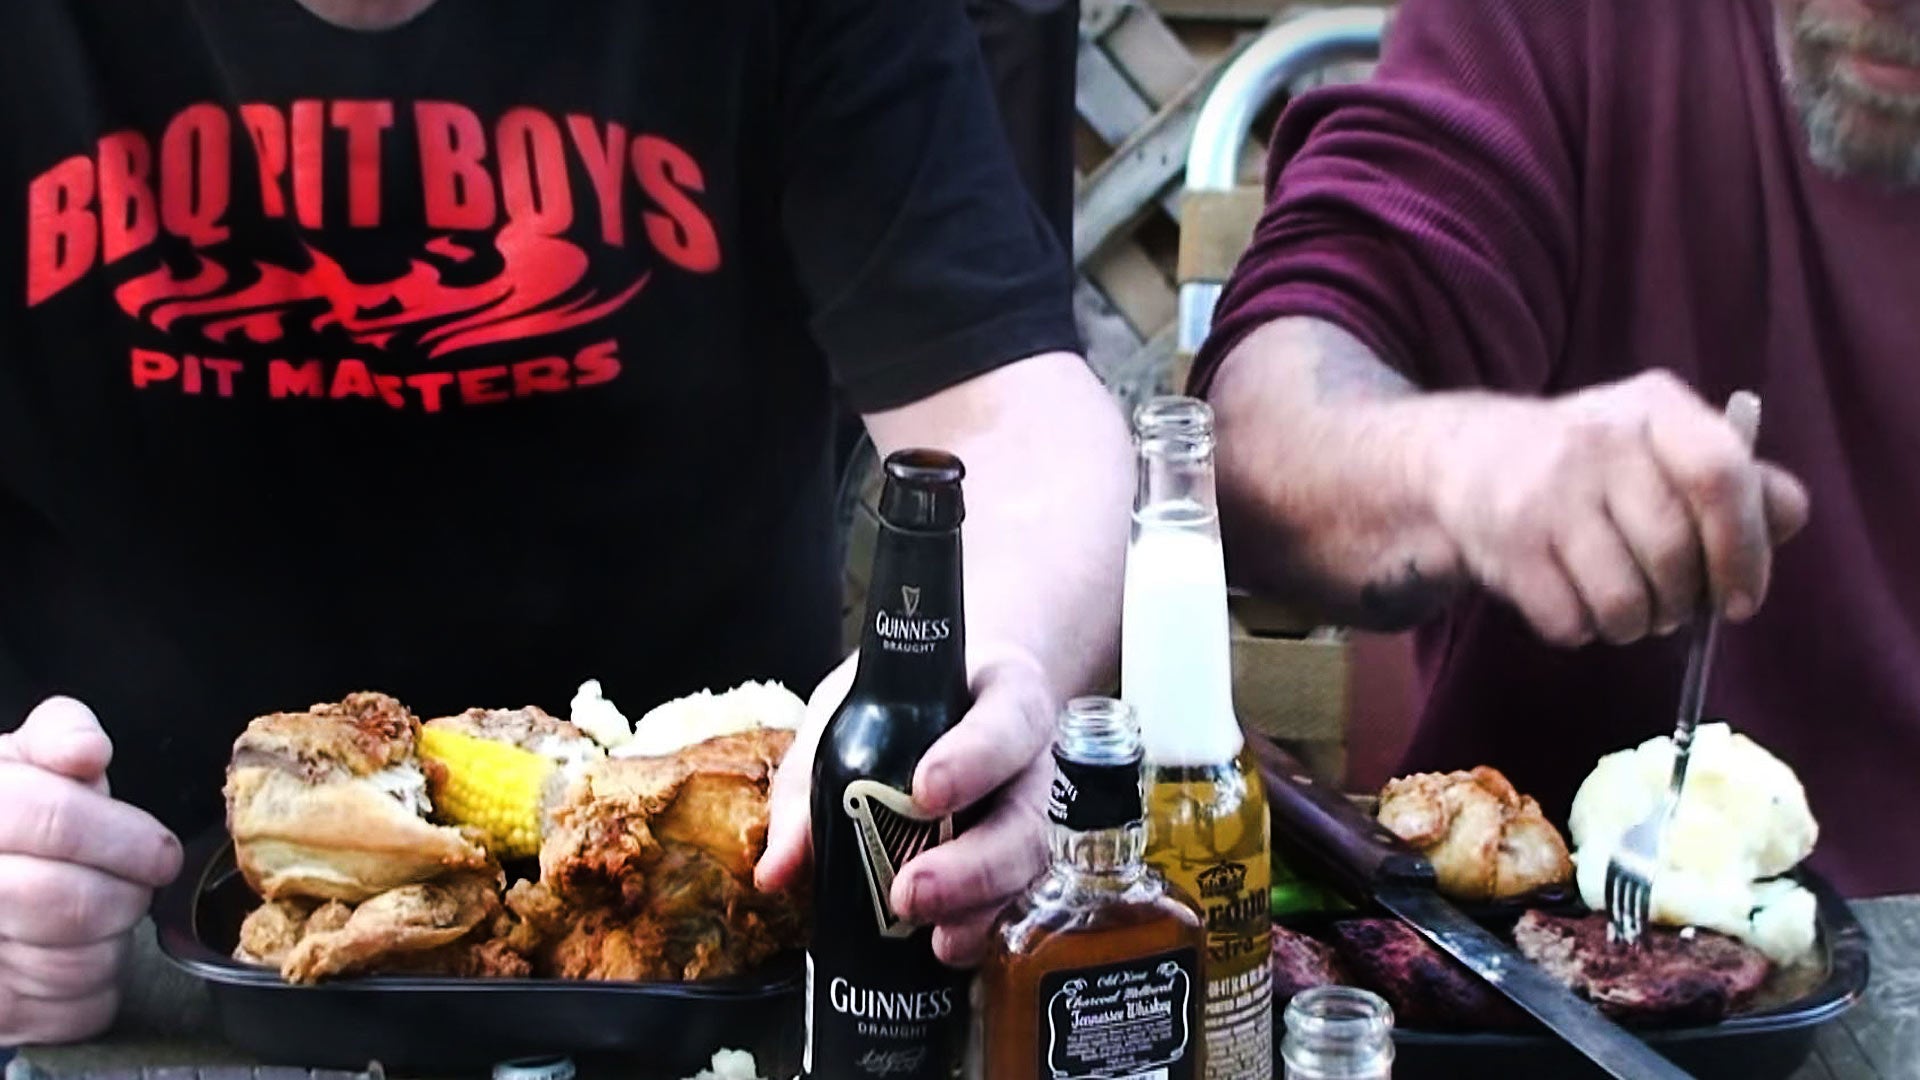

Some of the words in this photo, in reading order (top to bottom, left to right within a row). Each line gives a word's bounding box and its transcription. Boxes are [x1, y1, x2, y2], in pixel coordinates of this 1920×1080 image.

[28, 104, 231, 308] BBQ
[240, 99, 394, 229] PIT
[414, 101, 722, 274] BOYS
[131, 348, 244, 398] PIT
[269, 340, 622, 413] MASTERS
[876, 609, 950, 641] GUINNESS
[883, 641, 936, 653] DRAUGHT
[830, 977, 952, 1021] GUINNESS
[858, 1021, 928, 1037] DRAUGHT
